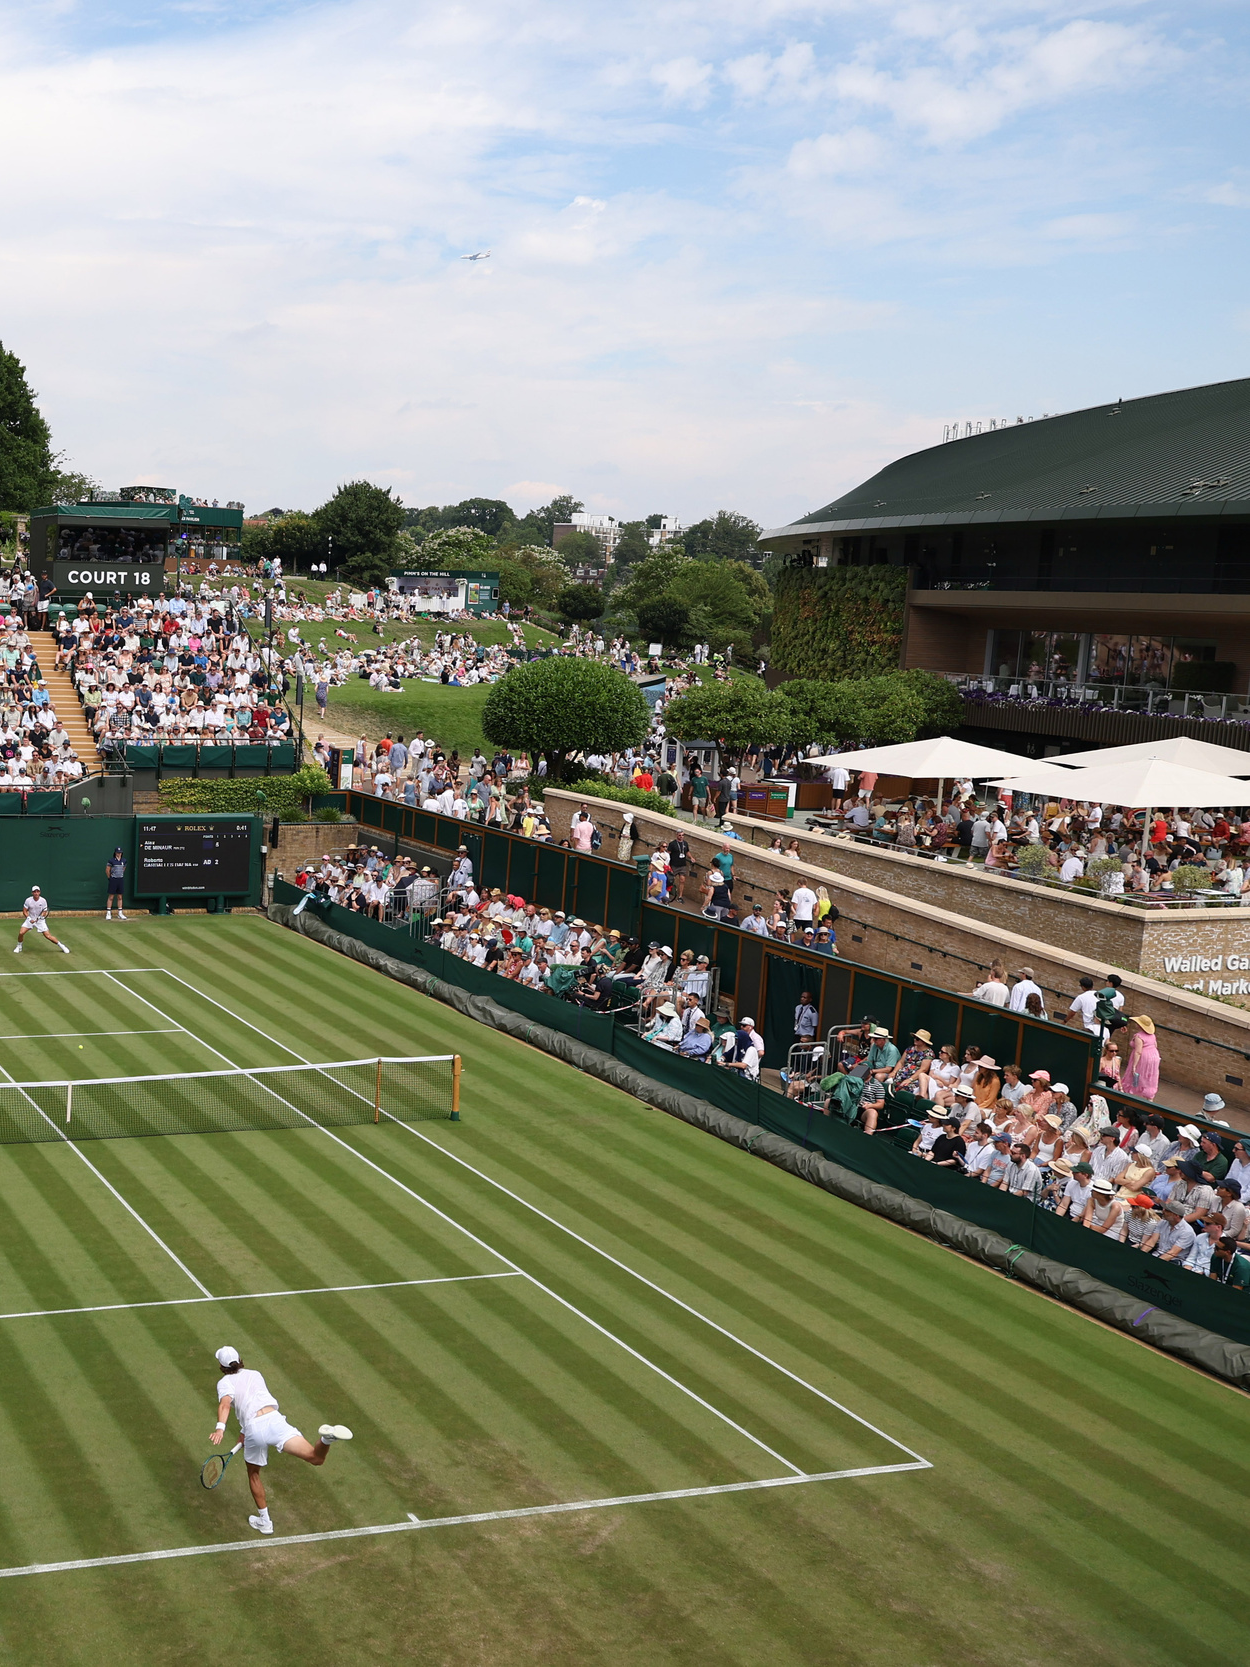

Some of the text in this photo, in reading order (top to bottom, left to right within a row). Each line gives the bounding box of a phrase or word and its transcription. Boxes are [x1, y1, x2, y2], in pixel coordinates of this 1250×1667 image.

[67, 570, 151, 585] COURT 18
[39, 831, 71, 839] Slazenger
[1164, 954, 1250, 973] Walled Ga
[1127, 1275, 1183, 1306] Slazenger
